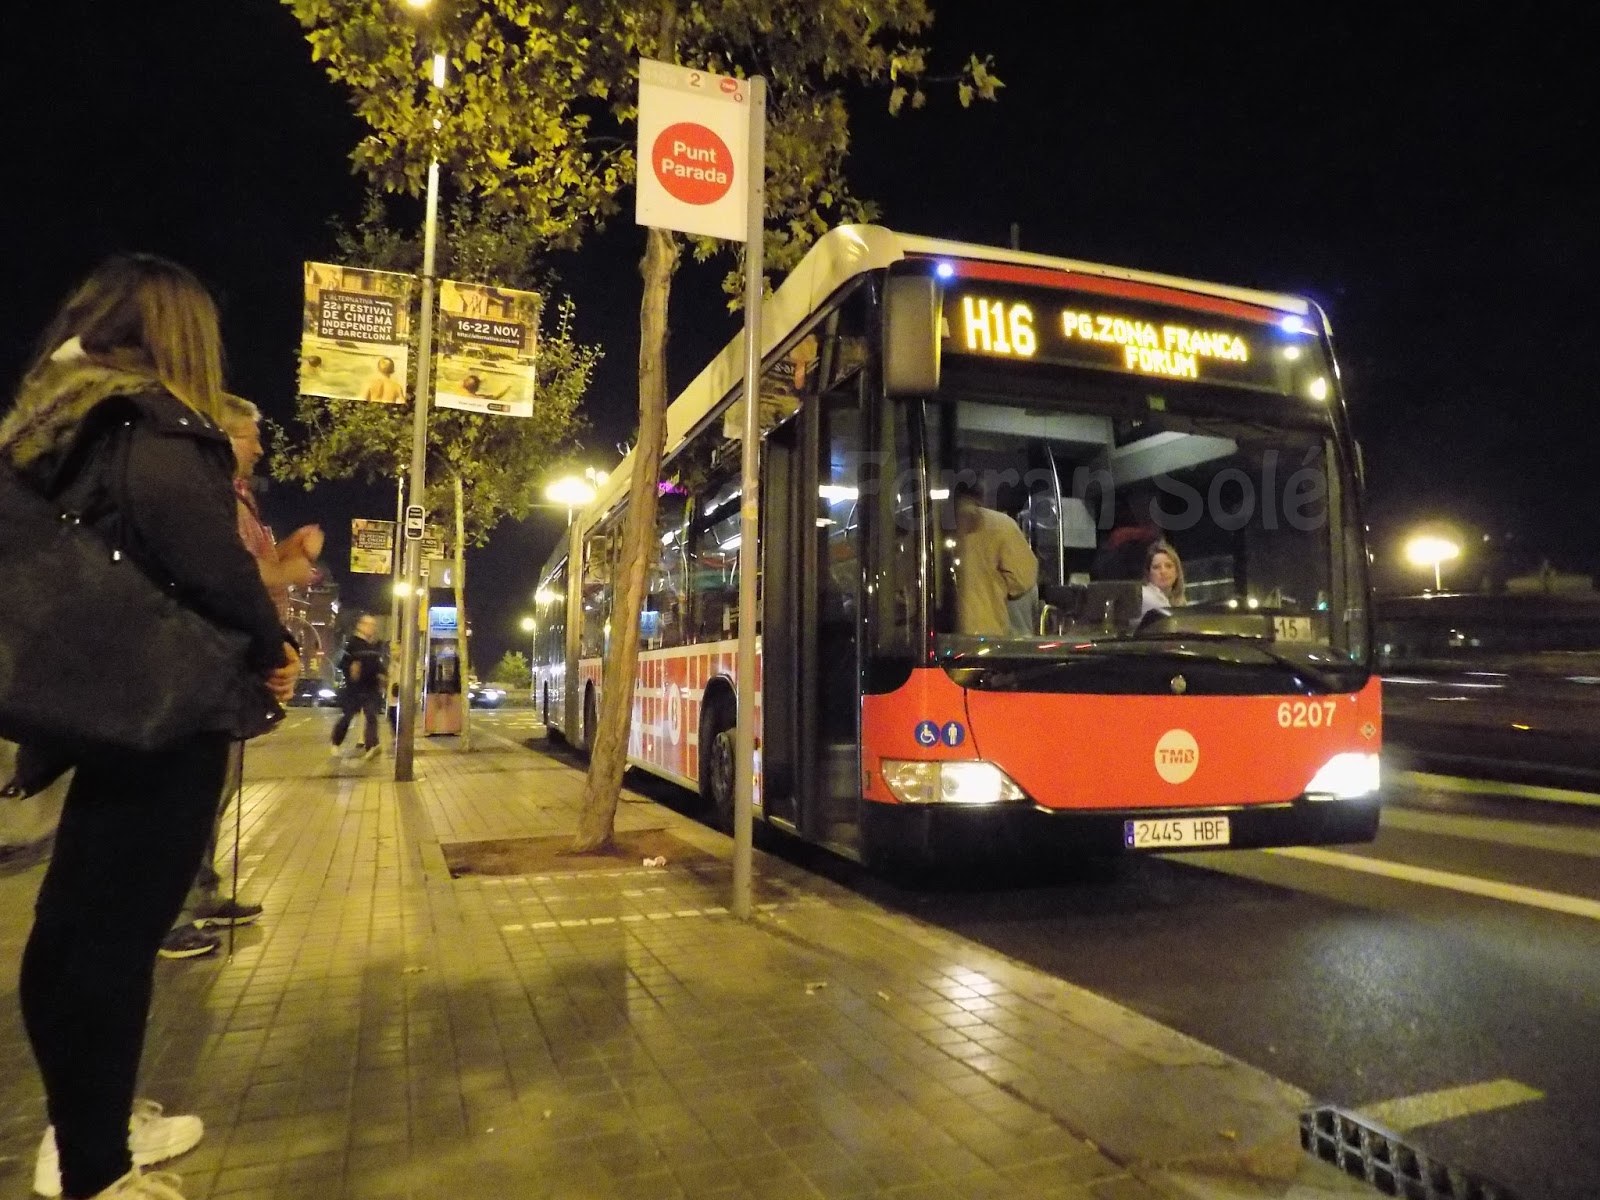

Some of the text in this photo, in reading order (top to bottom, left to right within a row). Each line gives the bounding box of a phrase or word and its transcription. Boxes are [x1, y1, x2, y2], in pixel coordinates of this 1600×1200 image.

[673, 140, 717, 164] Punt
[661, 158, 727, 185] Parada
[323, 310, 393, 326] DE CINEMA
[343, 303, 393, 316] FESTIVAL
[321, 327, 392, 341] DE BARCELONA
[322, 319, 393, 334] INDEPENDENT
[458, 320, 520, 338] 16-22 NOV.
[962, 296, 1036, 356] H16
[1125, 345, 1198, 379] FORUM
[1277, 701, 1337, 728] 6207
[1159, 749, 1195, 764] TMB
[1139, 821, 1183, 843] 2445
[1193, 820, 1225, 841] HBF
